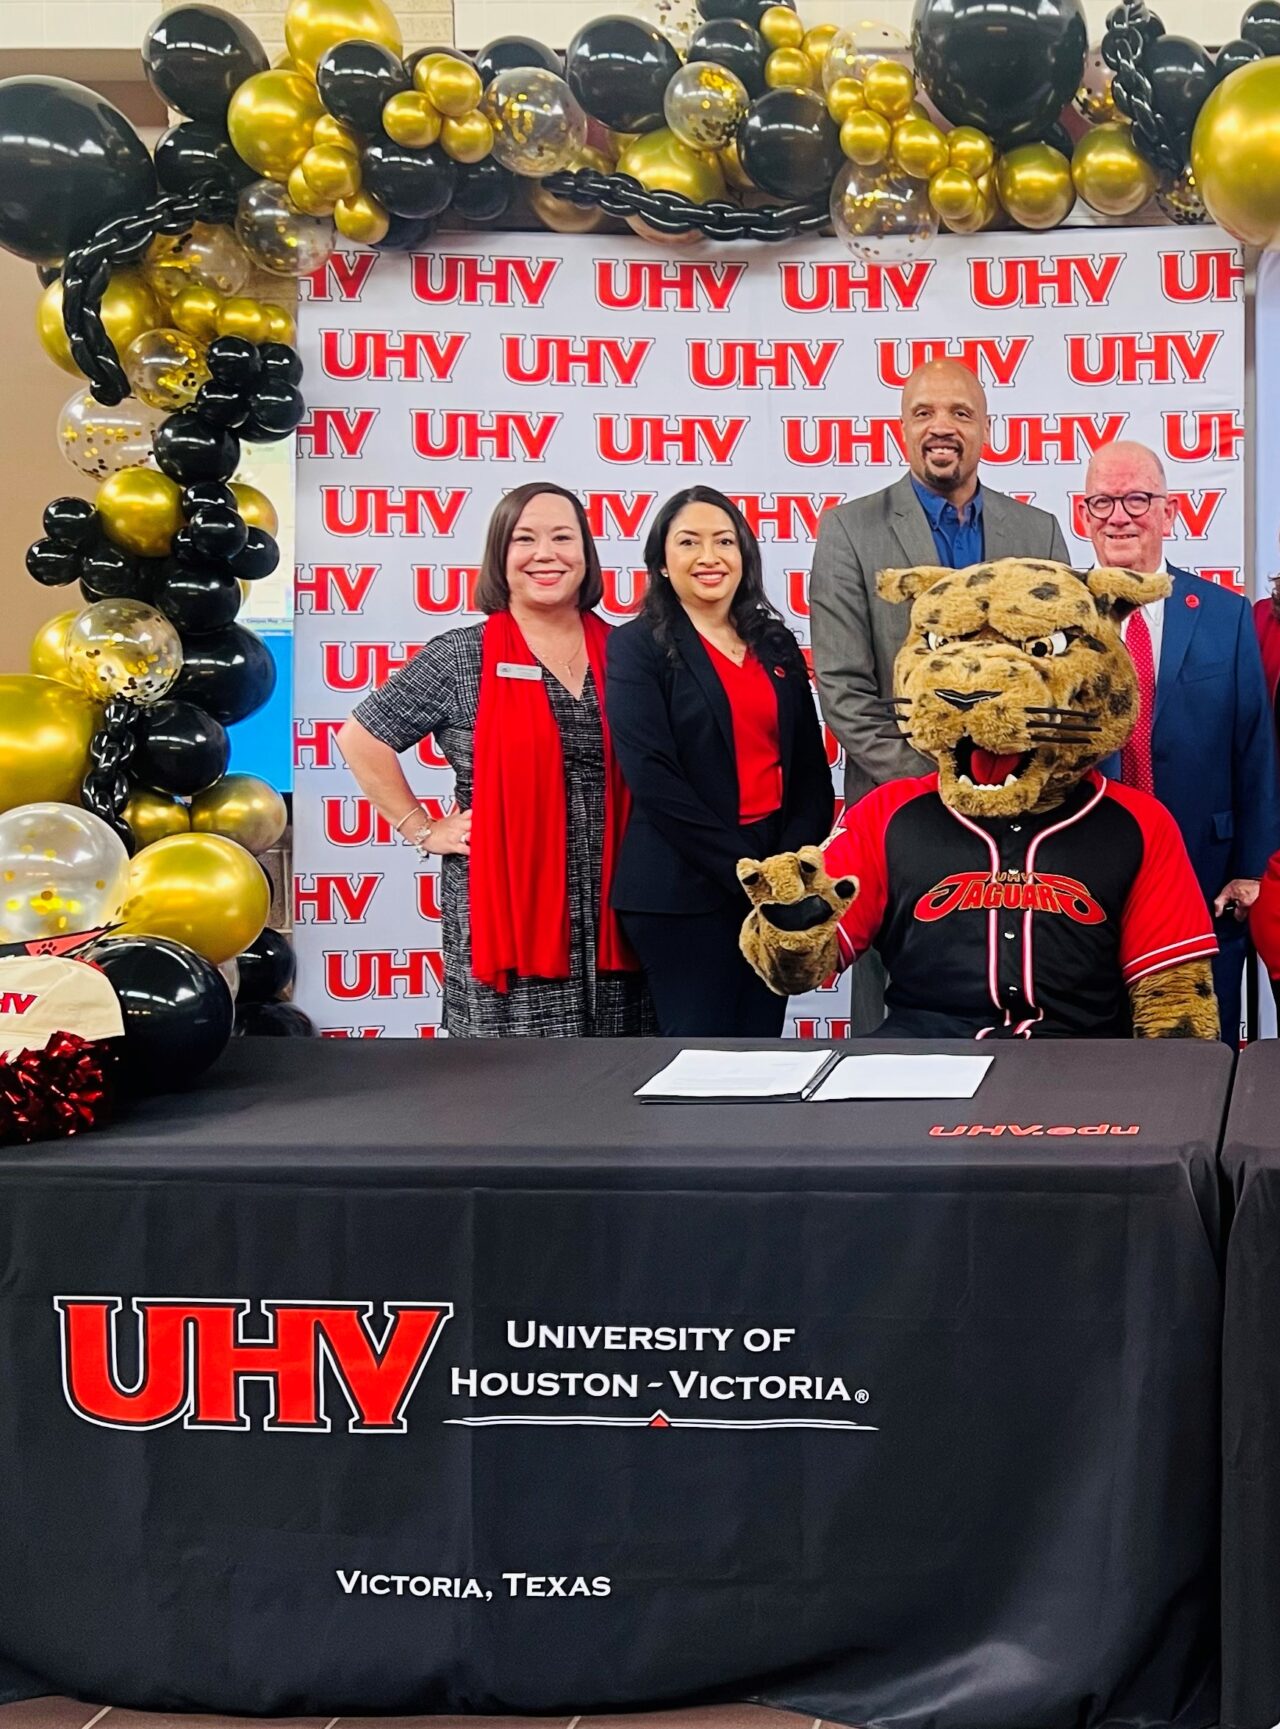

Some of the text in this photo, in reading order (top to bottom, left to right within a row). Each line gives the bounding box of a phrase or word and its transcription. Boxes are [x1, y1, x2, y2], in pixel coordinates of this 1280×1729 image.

[409, 252, 563, 308] UHV
[594, 258, 748, 313] UHV
[778, 258, 937, 313] UHV
[967, 253, 1128, 310] UHV
[319, 328, 471, 382] UHV
[500, 333, 656, 388] UHV
[687, 337, 844, 390] UHV
[1064, 330, 1224, 386] UHV
[409, 409, 563, 462] UHV
[594, 413, 751, 466] UHV
[320, 485, 472, 538] UHV
[913, 872, 1107, 925] JAGUARS
[929, 1123, 1140, 1137] UHV.edu
[507, 1319, 796, 1352] UNIVERSITY OF
[54, 1296, 454, 1435] UHV
[450, 1368, 639, 1399] HOUSTON
[336, 1569, 612, 1602] VICTORIA, TEXAS
